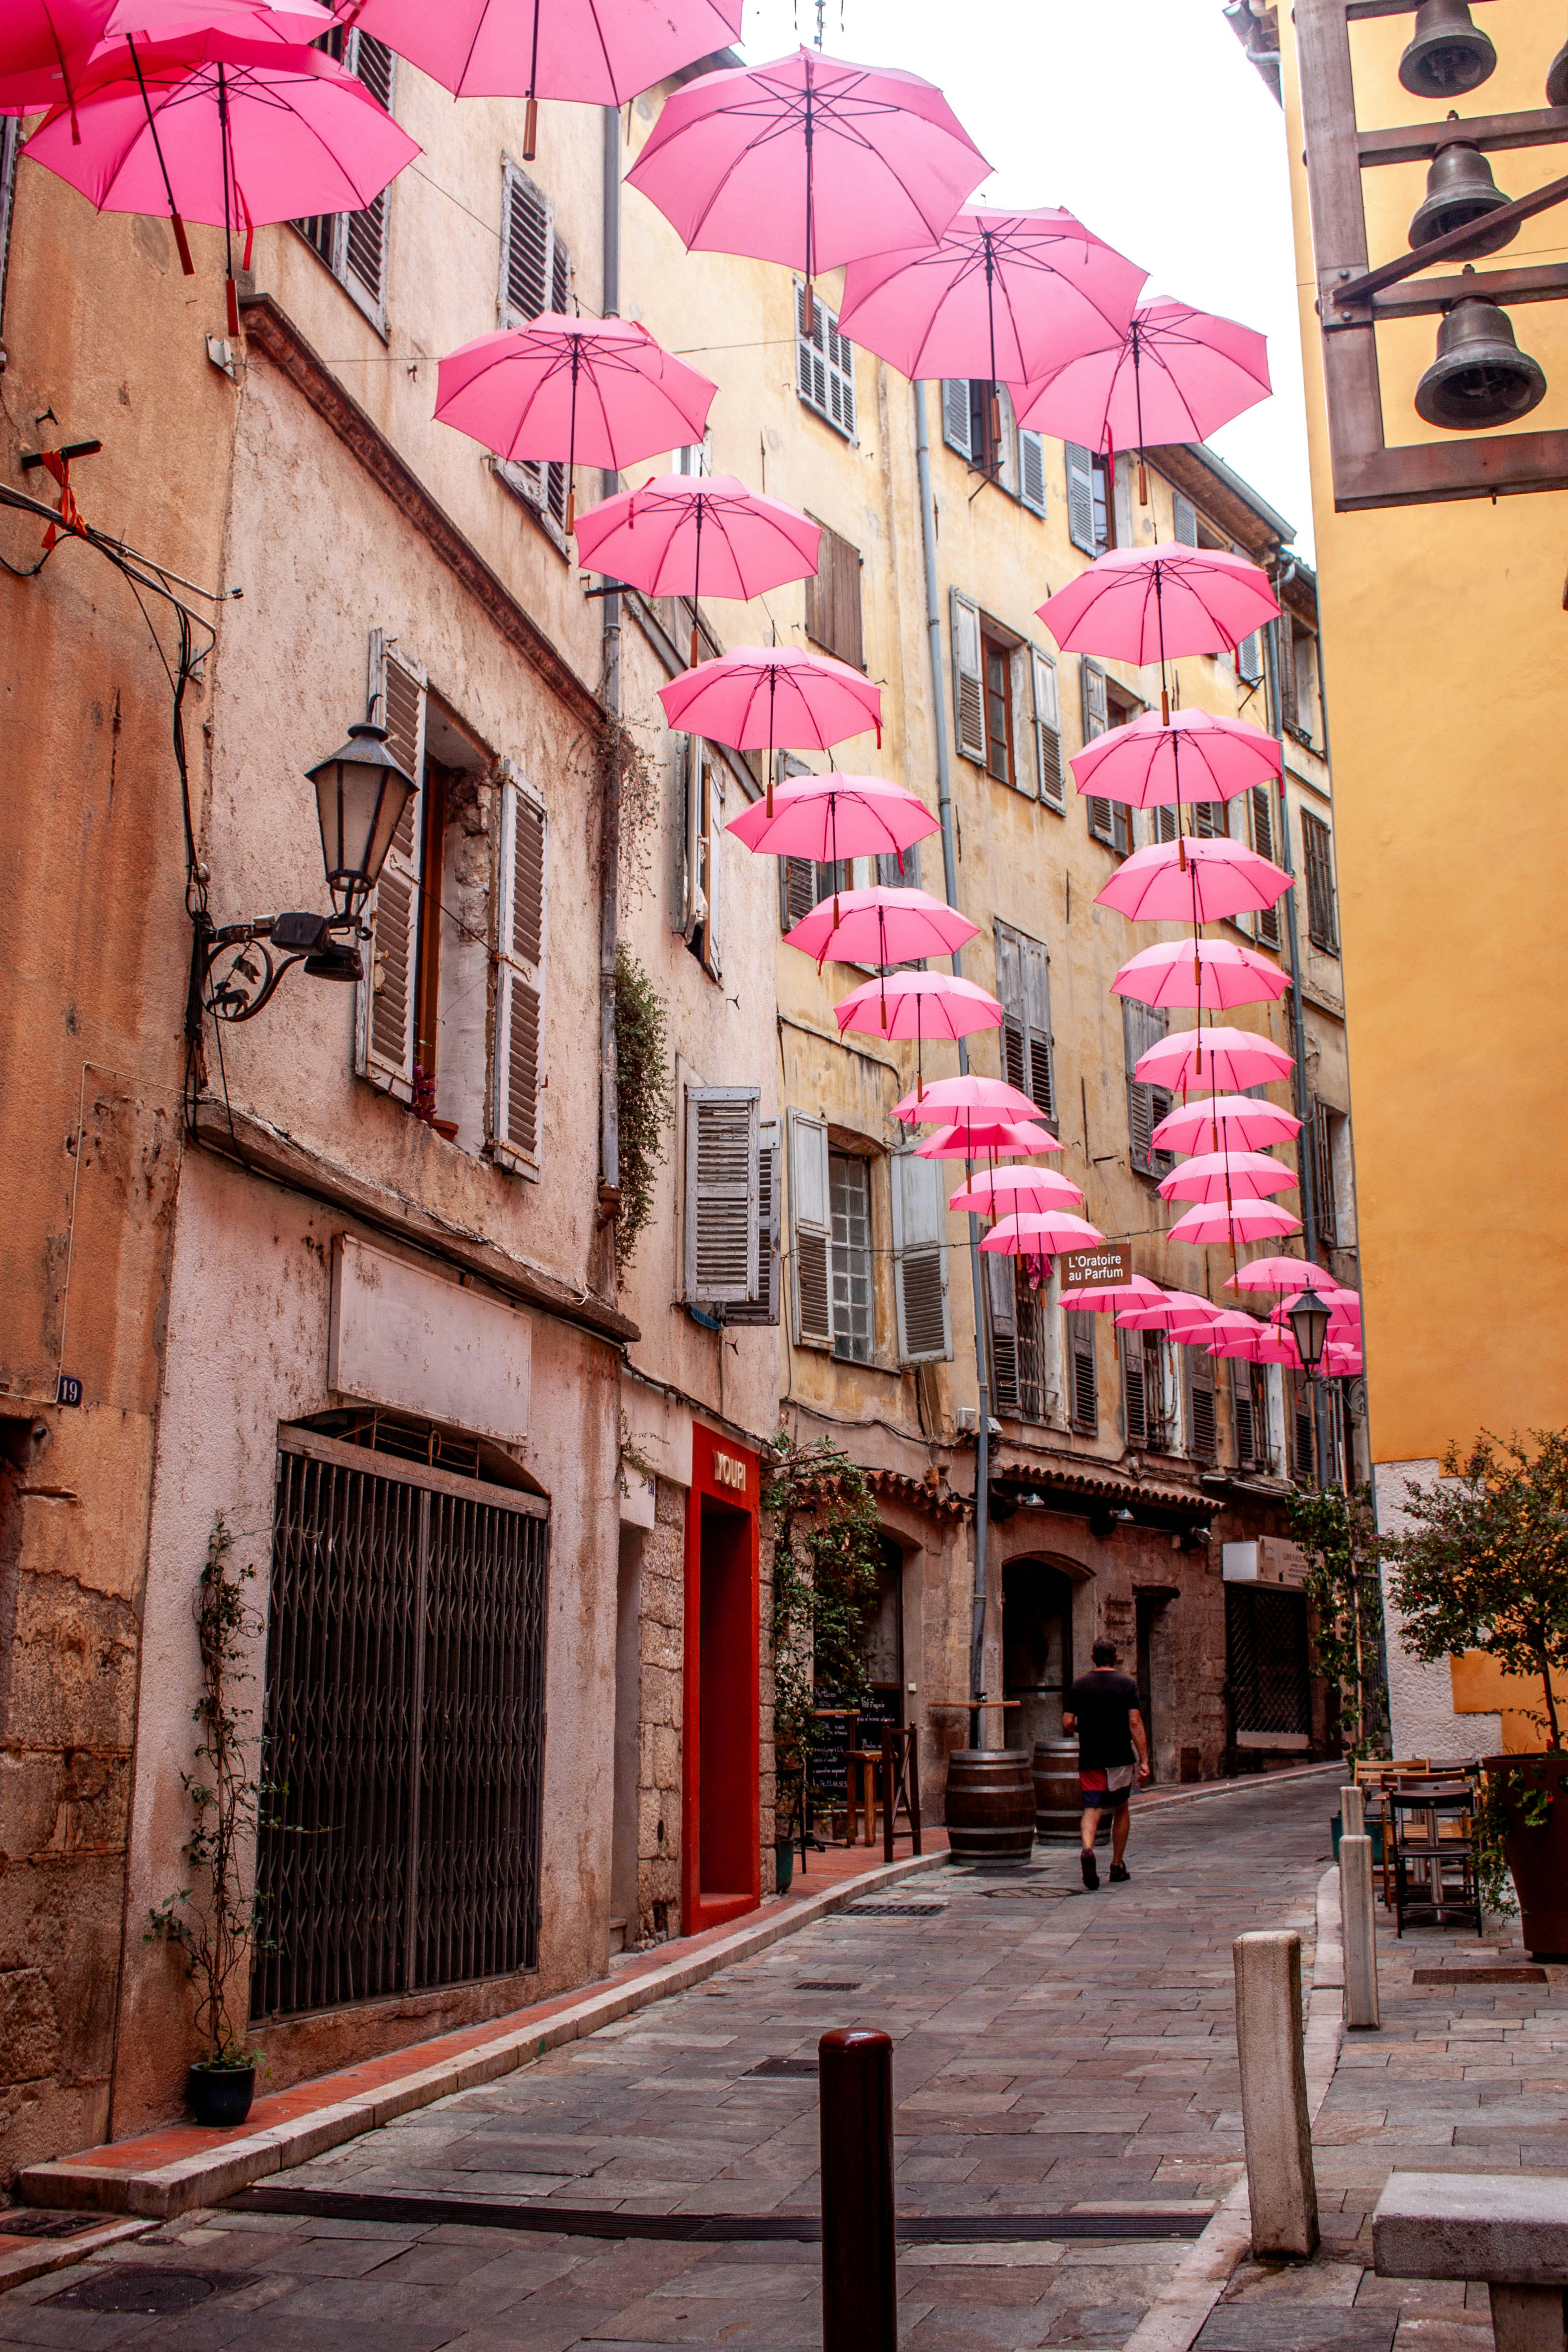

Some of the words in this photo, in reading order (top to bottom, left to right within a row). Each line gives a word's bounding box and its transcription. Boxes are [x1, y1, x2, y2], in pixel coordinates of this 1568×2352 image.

[1069, 1254, 1122, 1268] L'Oratoire
[1069, 1271, 1081, 1281] au
[1085, 1267, 1123, 1280] Parfum
[62, 1379, 78, 1402] 19
[713, 1450, 746, 1491] YOUPI
